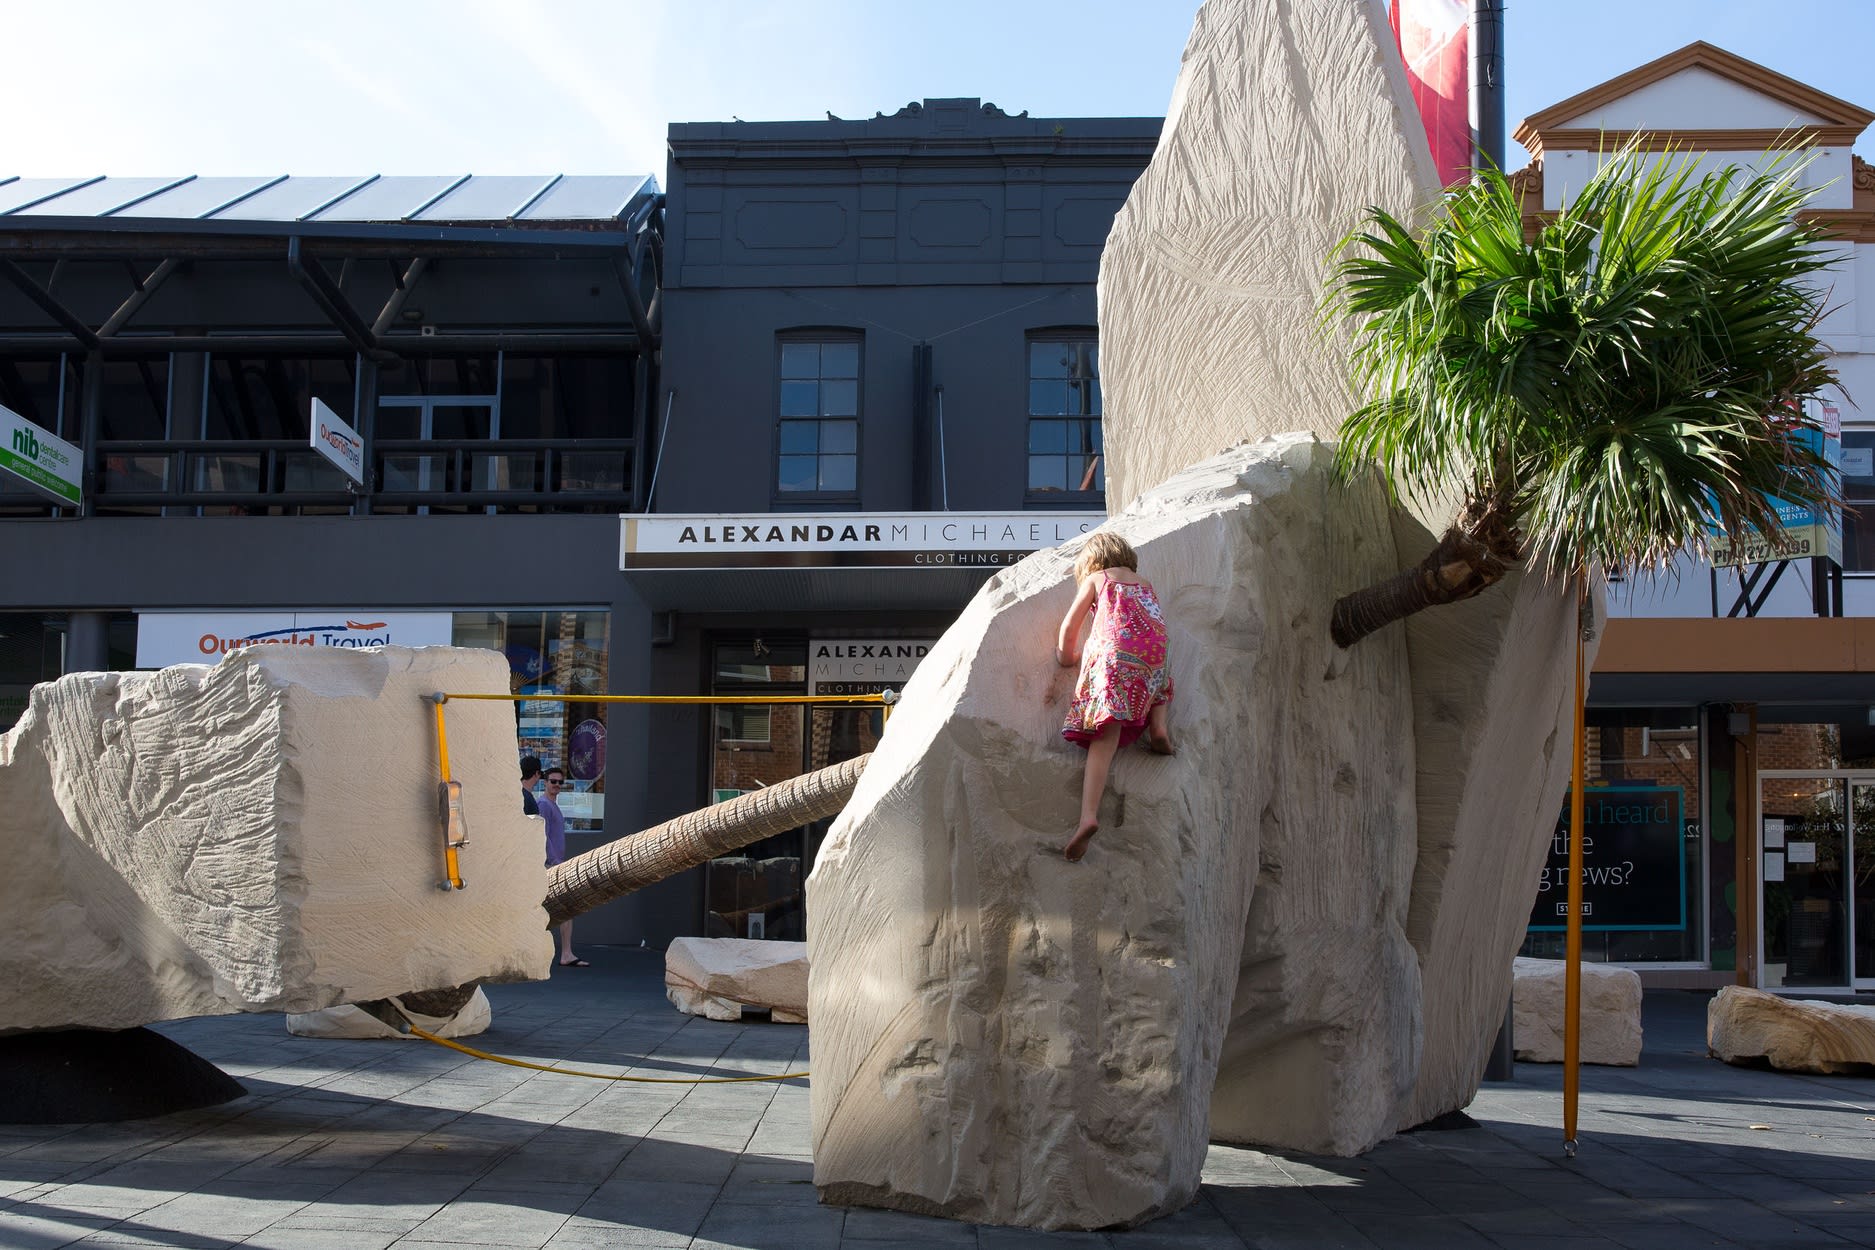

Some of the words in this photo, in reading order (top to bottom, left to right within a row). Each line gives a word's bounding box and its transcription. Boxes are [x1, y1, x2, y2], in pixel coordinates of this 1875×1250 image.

[13, 427, 39, 460] nib
[40, 442, 69, 465] dentalcare
[40, 455, 57, 471] centre
[1780, 511, 1809, 521] GENTS
[678, 525, 881, 543] ALEXANDAR
[891, 523, 1089, 541] MICHAELS
[914, 553, 999, 564] CLOTHING
[1008, 553, 1026, 564] FO
[322, 633, 390, 649] Travel
[816, 645, 929, 658] ALEXAND
[815, 663, 907, 676] MICHA
[1599, 799, 1670, 825] heard
